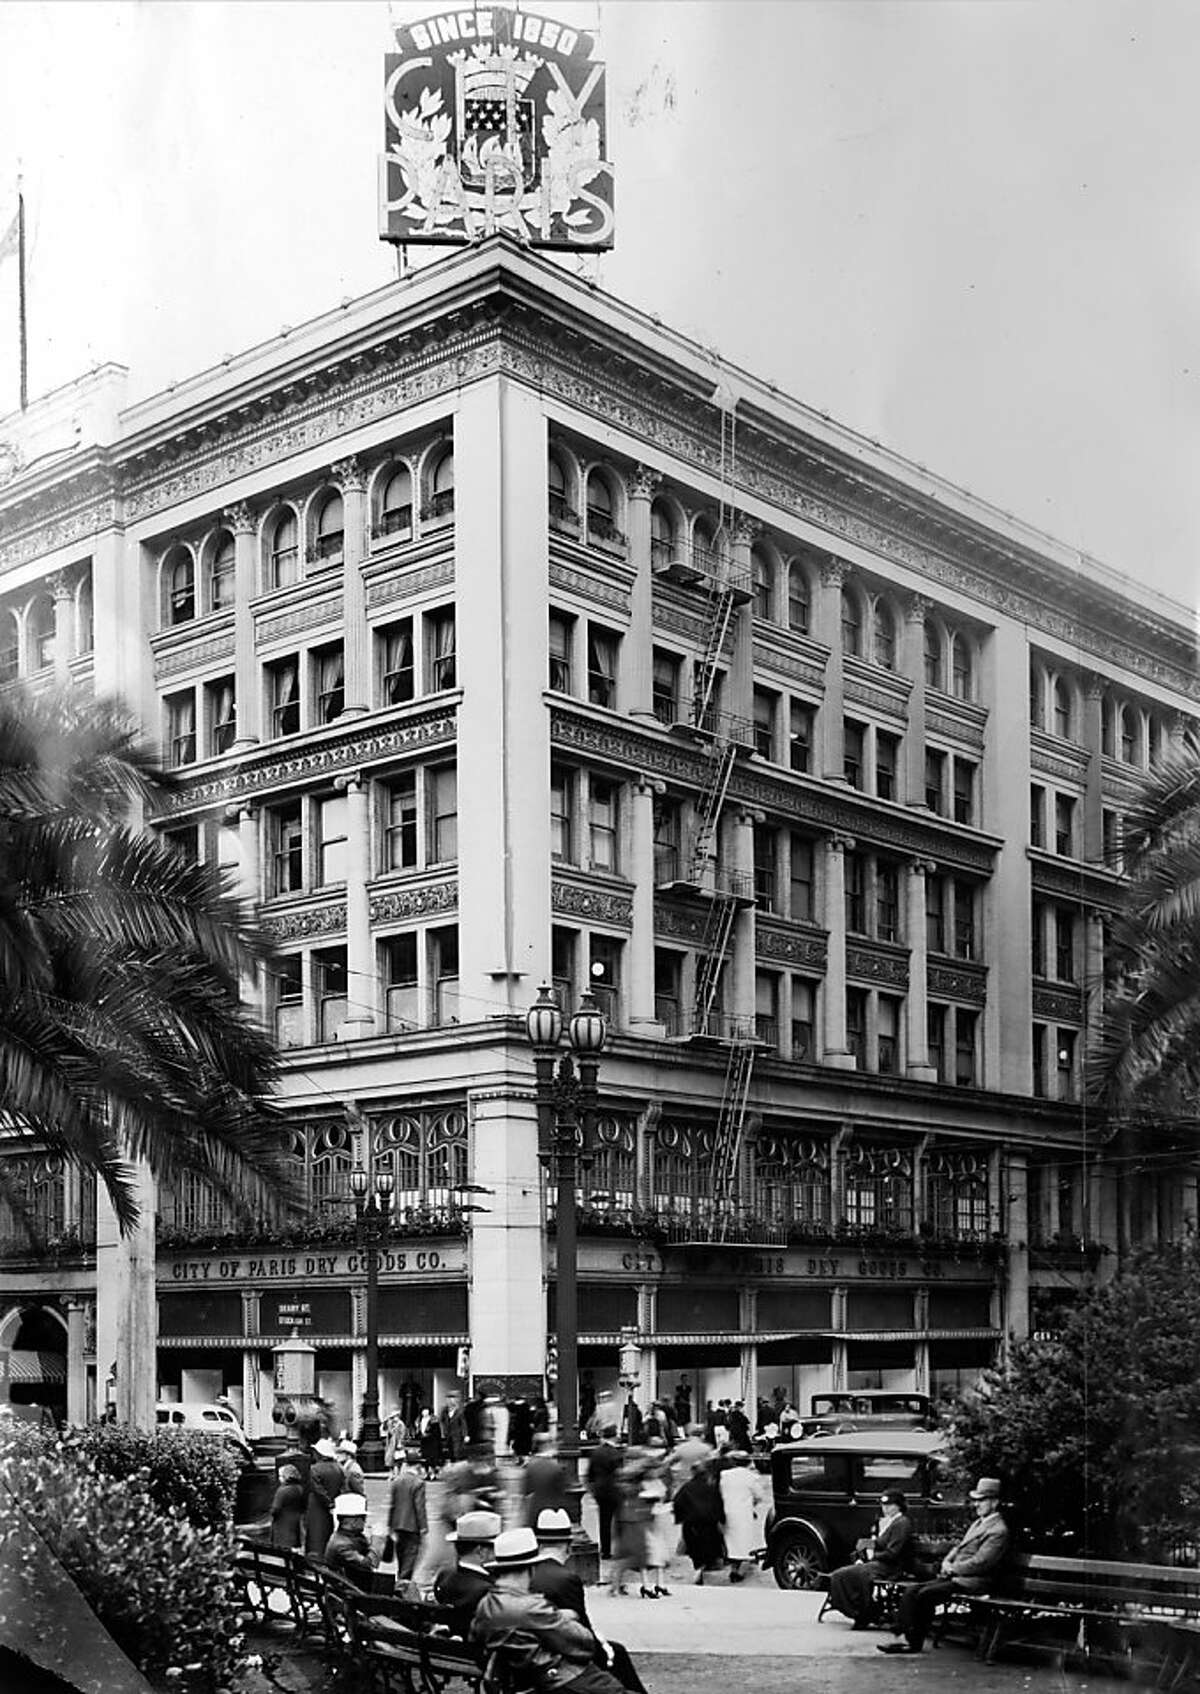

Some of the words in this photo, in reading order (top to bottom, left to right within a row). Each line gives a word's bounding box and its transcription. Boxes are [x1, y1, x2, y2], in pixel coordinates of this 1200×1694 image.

[409, 10, 494, 50] SINCE
[513, 13, 578, 56] 1850
[172, 1262, 210, 1279] CITY
[219, 1260, 239, 1277] OF
[248, 1258, 296, 1276] PARIS
[304, 1255, 338, 1274] DRY
[416, 1252, 446, 1270] CO.
